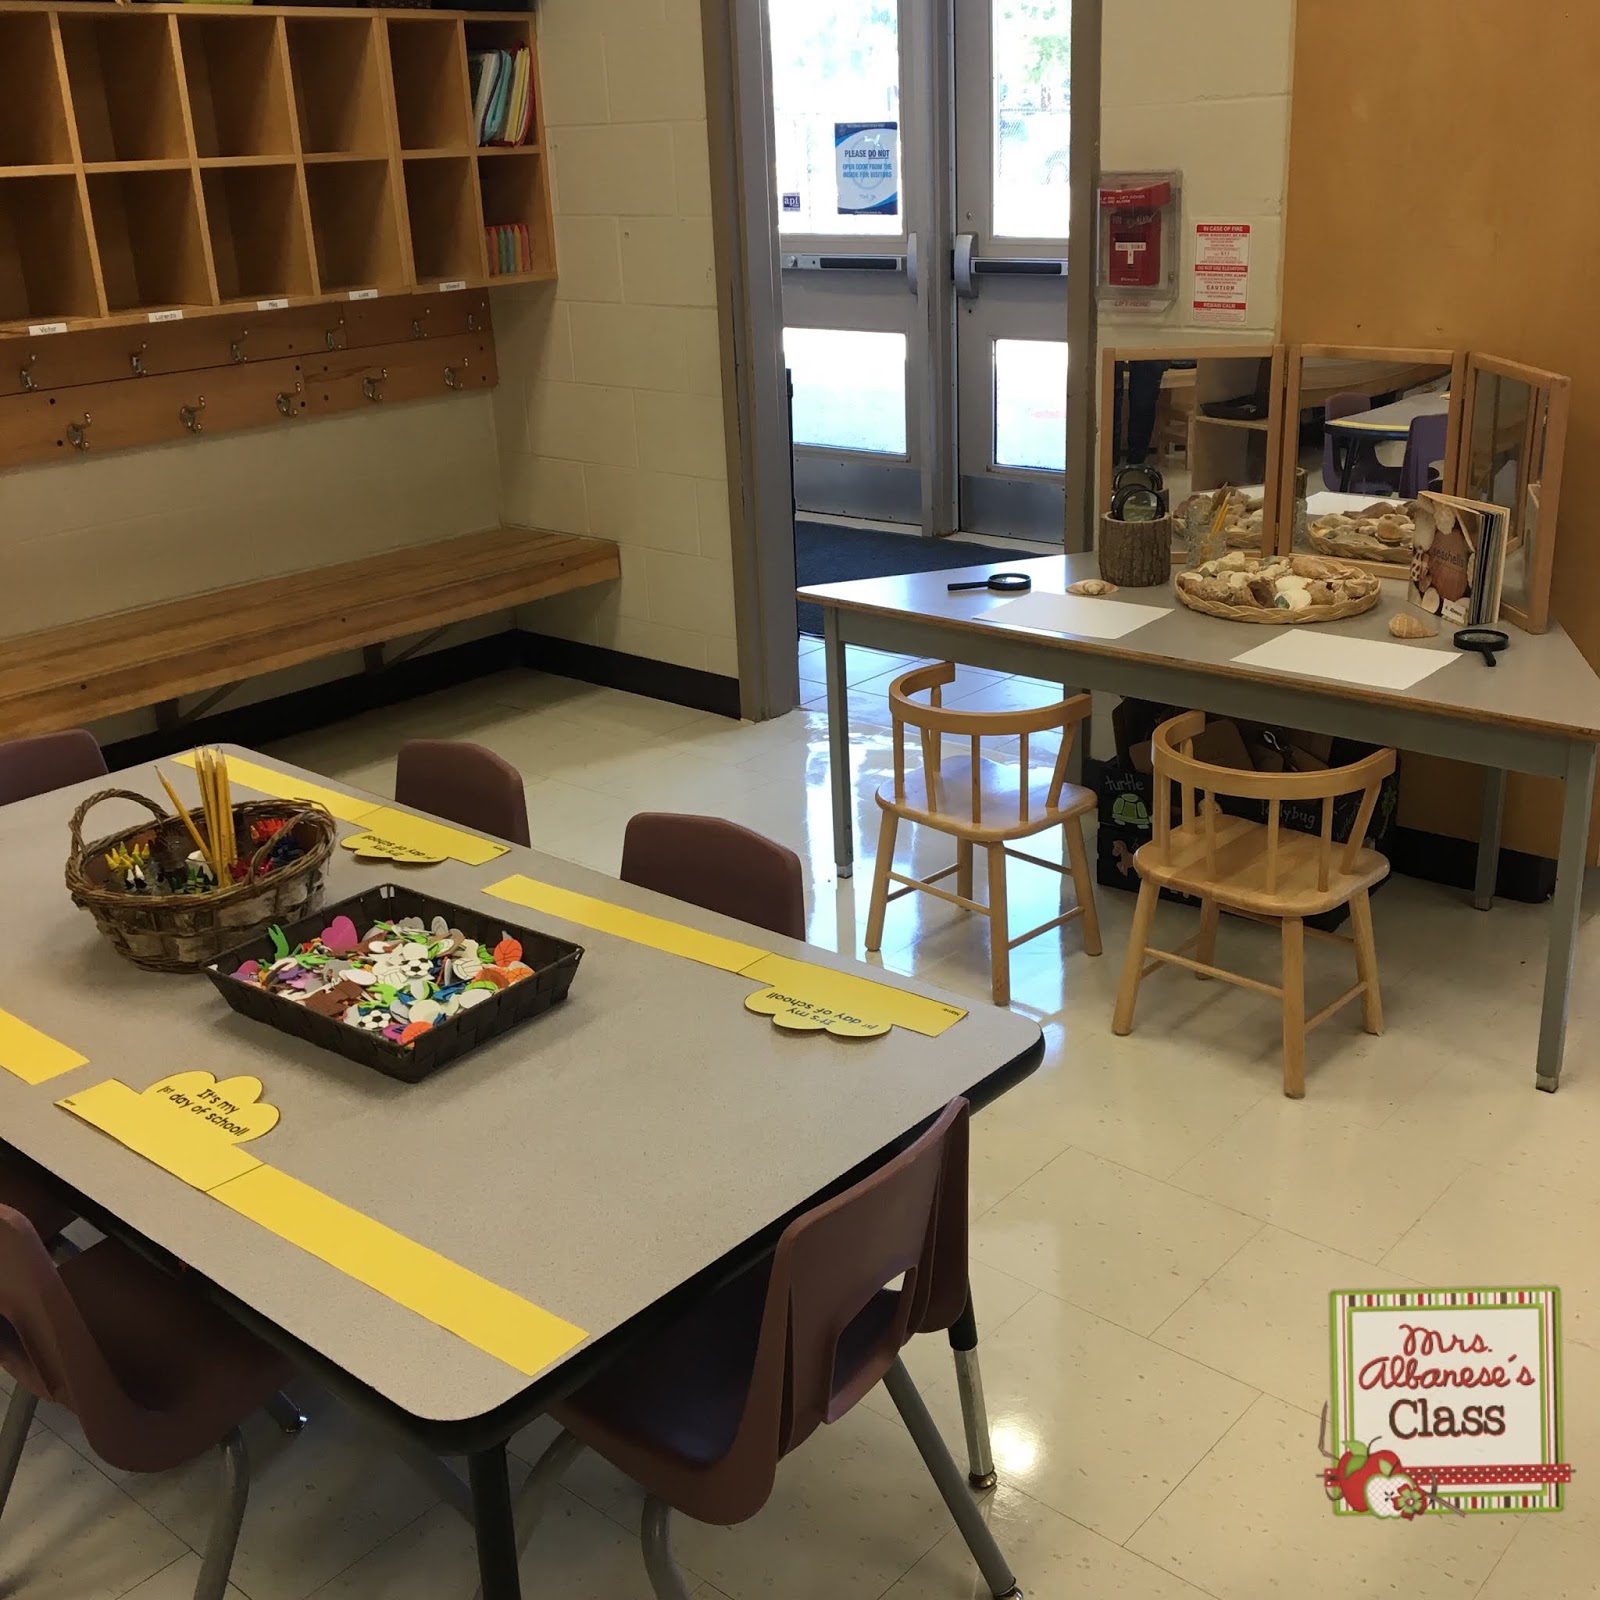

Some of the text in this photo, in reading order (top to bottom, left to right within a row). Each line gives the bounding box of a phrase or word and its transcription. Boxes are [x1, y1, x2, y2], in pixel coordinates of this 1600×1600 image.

[844, 149, 890, 158] PLEASE DO NOT
[1104, 773, 1145, 791] turtle
[766, 991, 815, 1010] school!
[786, 1007, 837, 1026] It's my
[813, 1007, 833, 1016] of
[834, 1012, 862, 1025] day
[196, 1088, 241, 1116] It's my
[168, 1093, 196, 1109] day
[190, 1105, 212, 1115] of
[204, 1113, 251, 1137] school!
